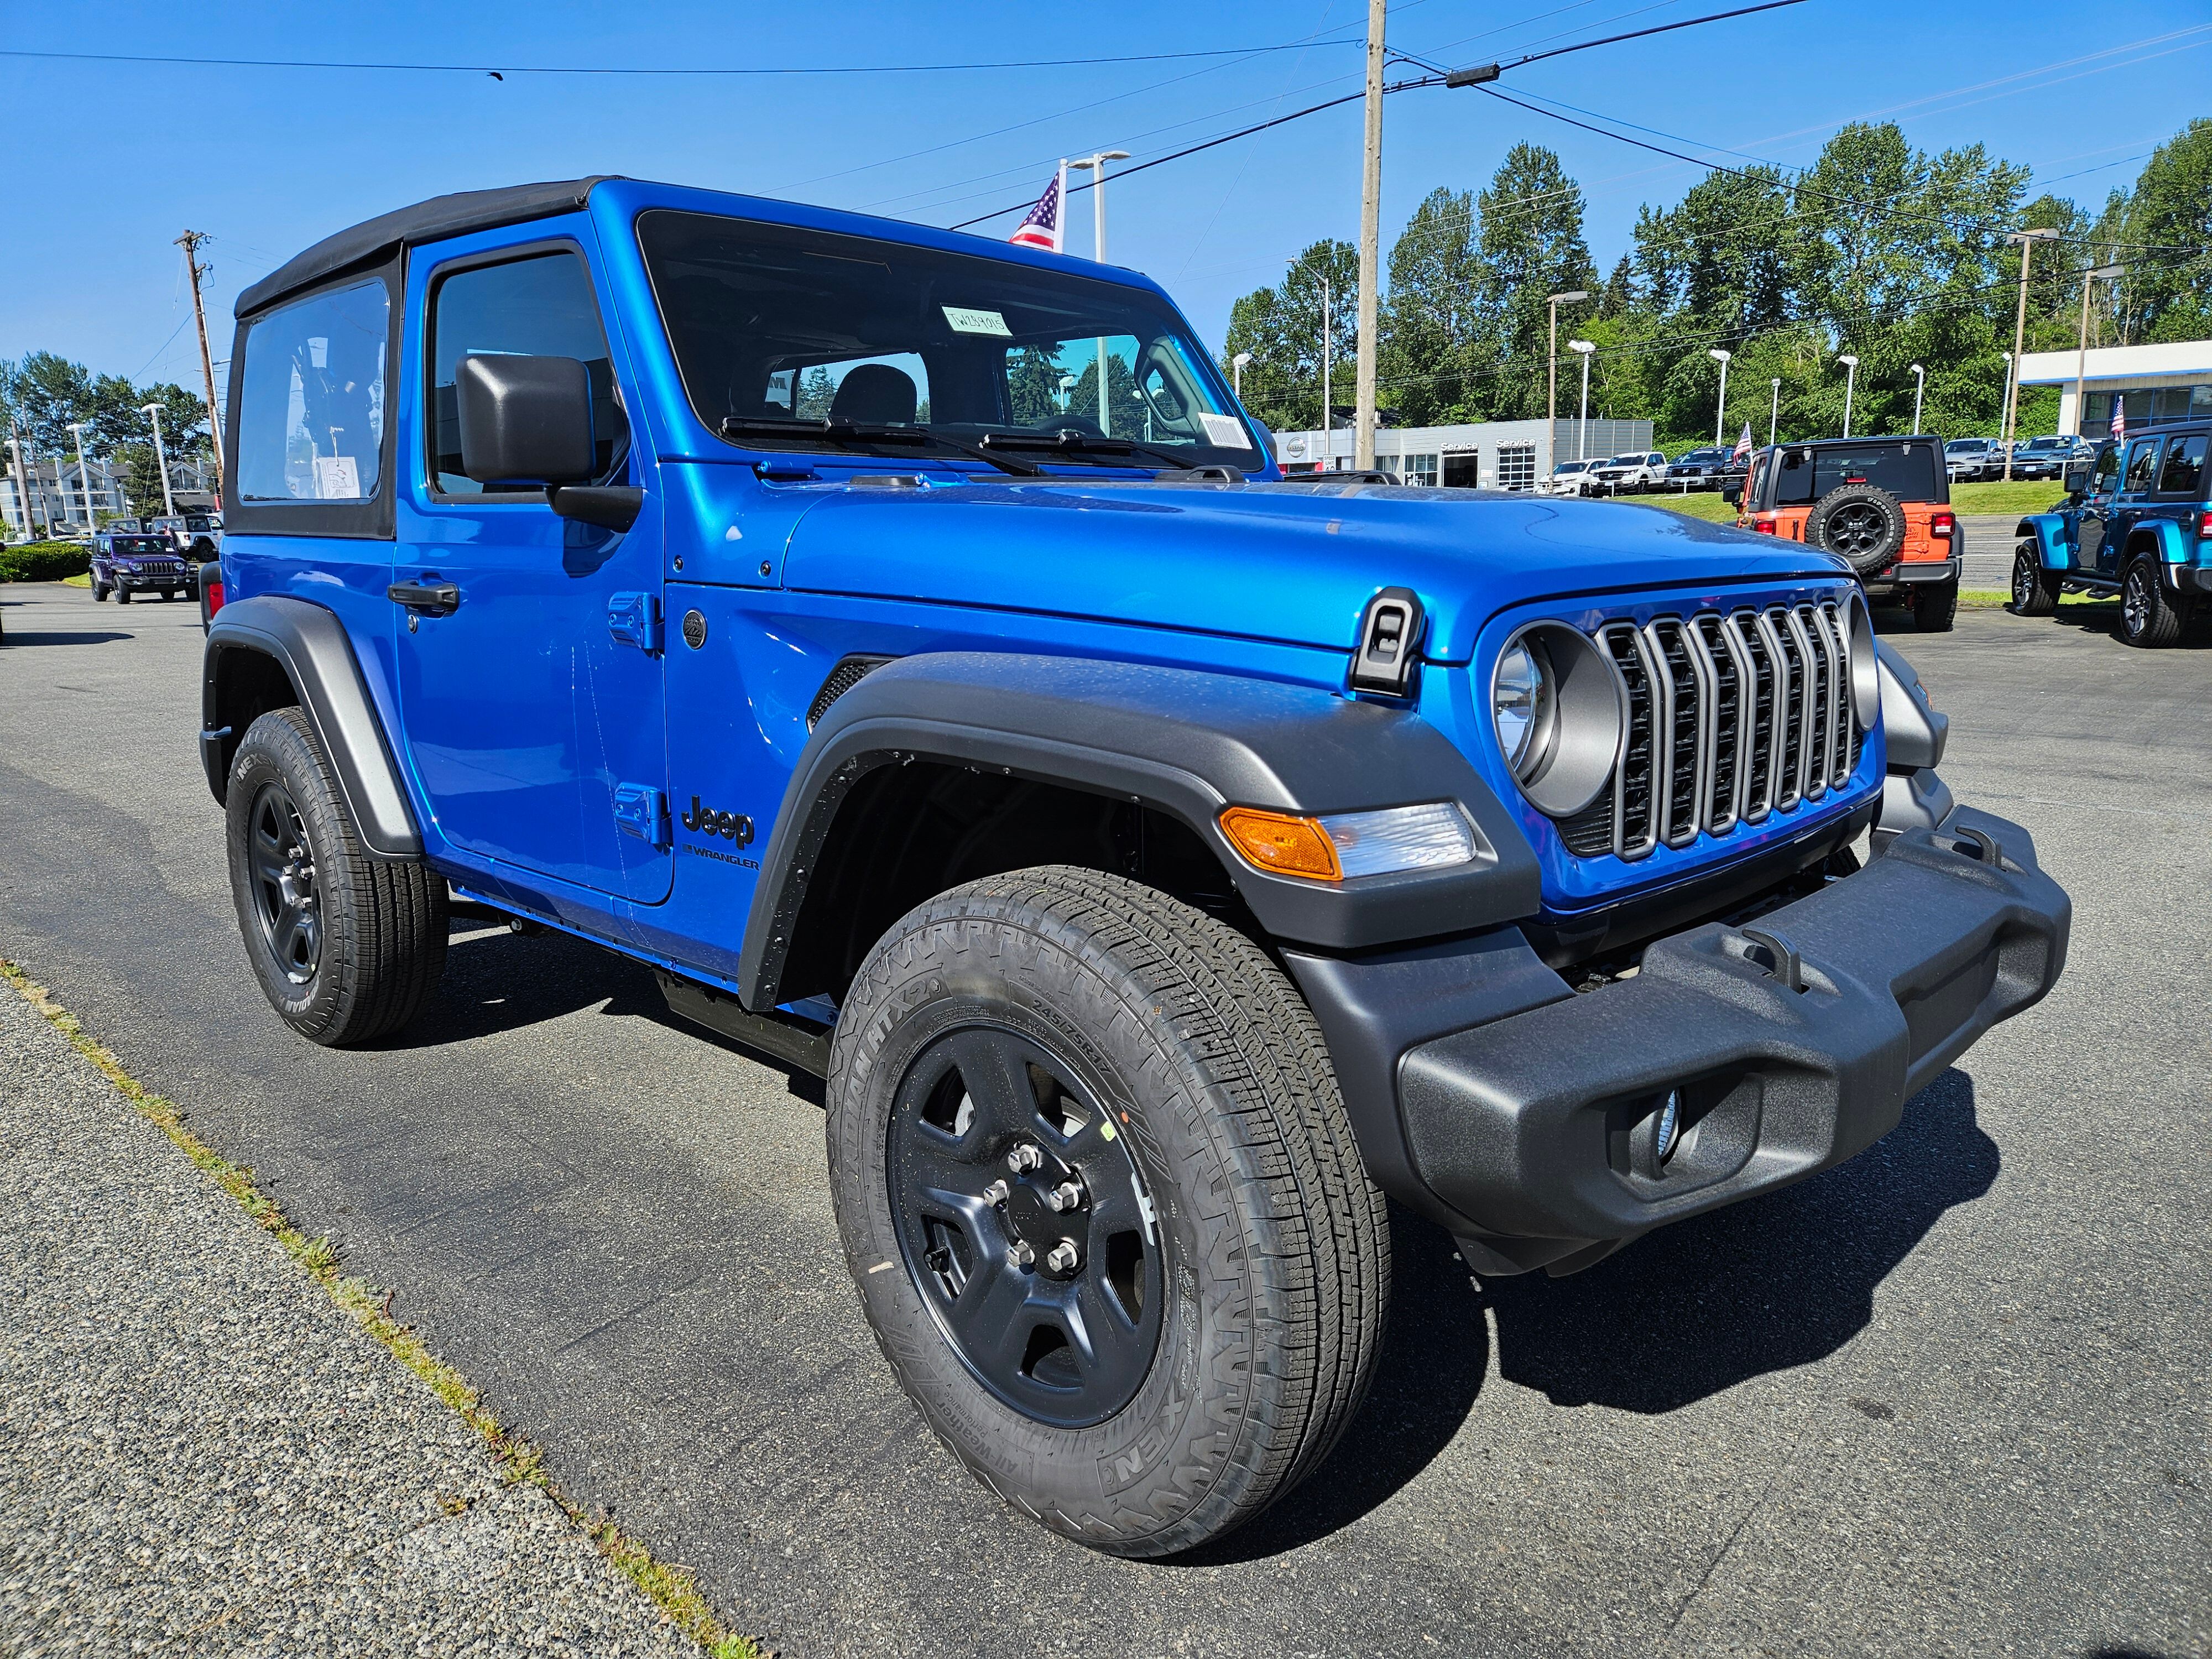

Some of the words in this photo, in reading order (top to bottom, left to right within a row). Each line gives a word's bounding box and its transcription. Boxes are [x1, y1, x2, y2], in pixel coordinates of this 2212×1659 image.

[947, 314, 1004, 330] TW289015
[1441, 442, 1479, 451] Service
[1496, 438, 1536, 448] Service
[681, 795, 754, 850] Jeep
[692, 846, 759, 871] WRANGLER
[1032, 999, 1112, 1073] 245/75R17
[944, 1392, 988, 1438] Performance
[936, 1402, 1018, 1474] All-Weather
